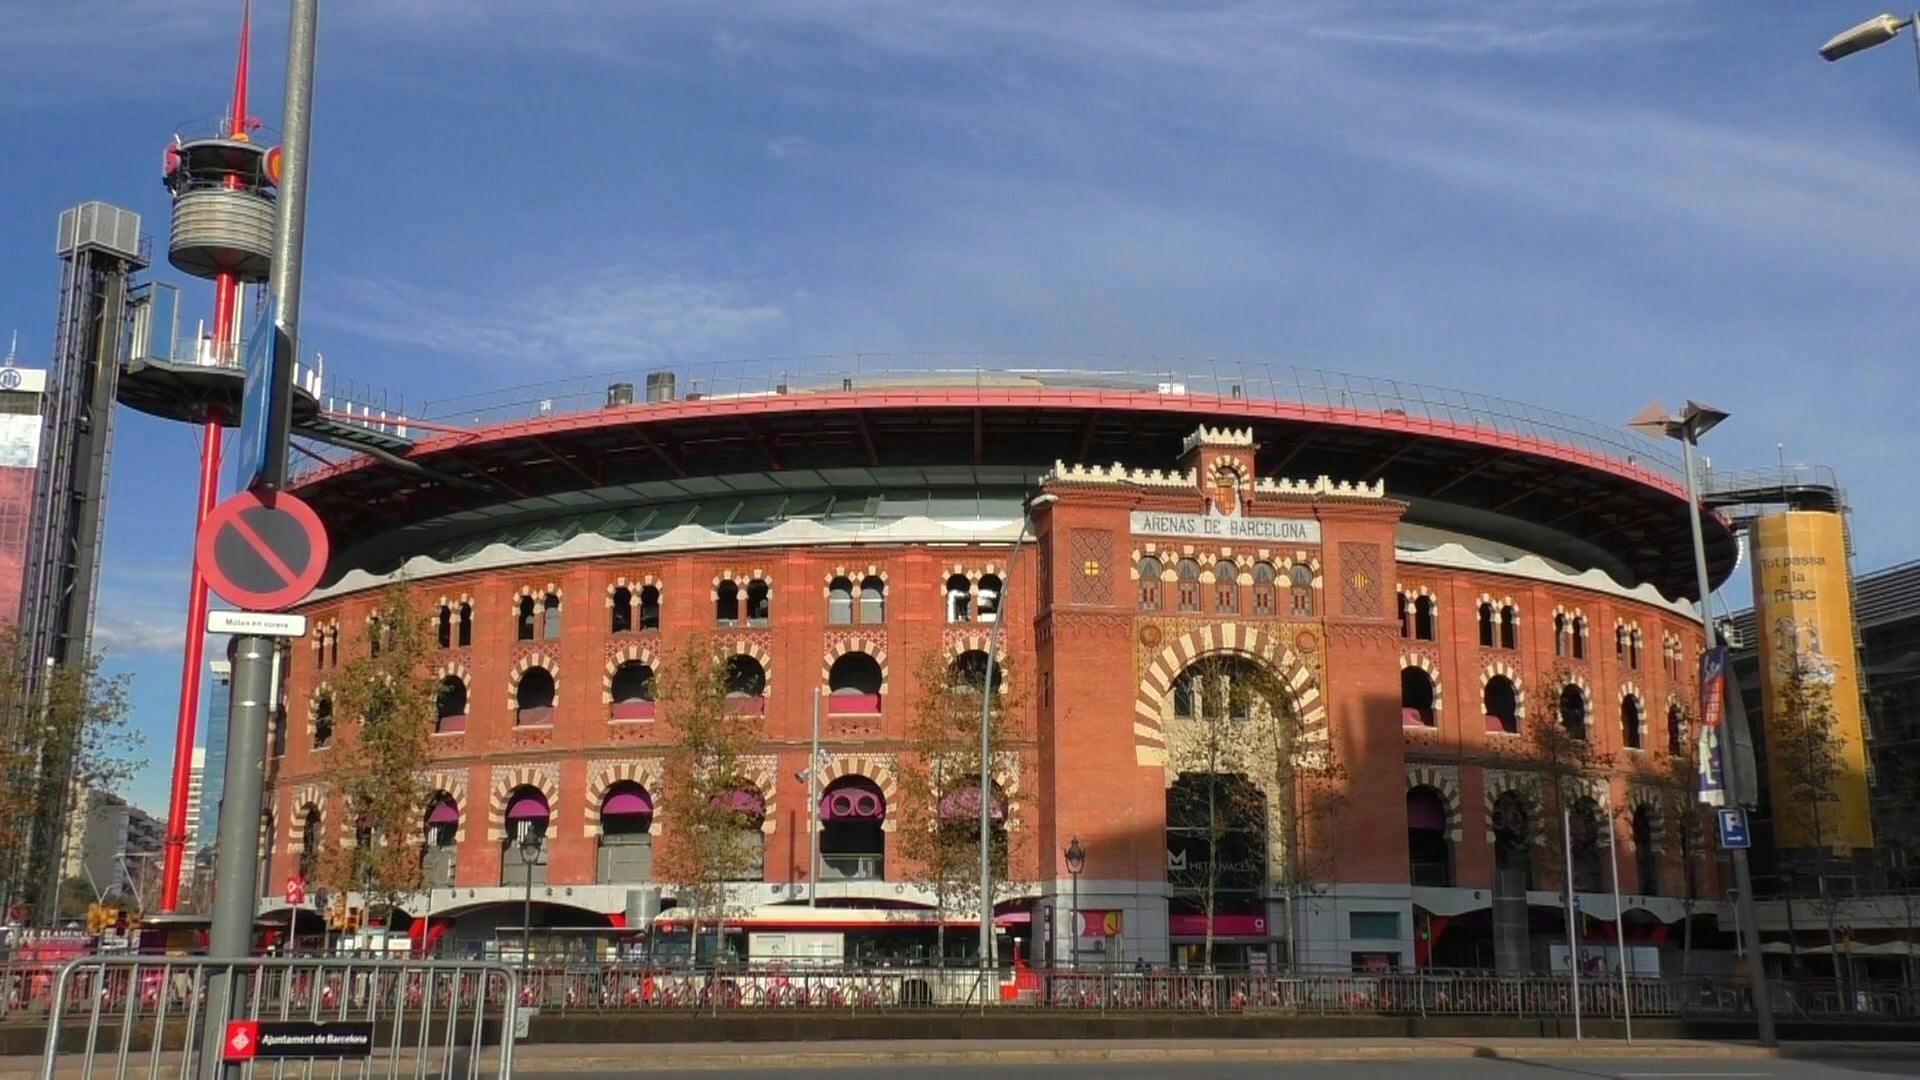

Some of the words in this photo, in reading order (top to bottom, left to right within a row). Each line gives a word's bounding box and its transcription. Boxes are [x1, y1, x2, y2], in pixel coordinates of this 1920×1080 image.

[1143, 516, 1195, 533] ARENAS
[1204, 518, 1221, 534] DE
[1230, 519, 1307, 538] BARCELONA
[261, 1034, 314, 1047] Ajuntament
[315, 1034, 326, 1044] de
[326, 1033, 368, 1045] Barcelona
